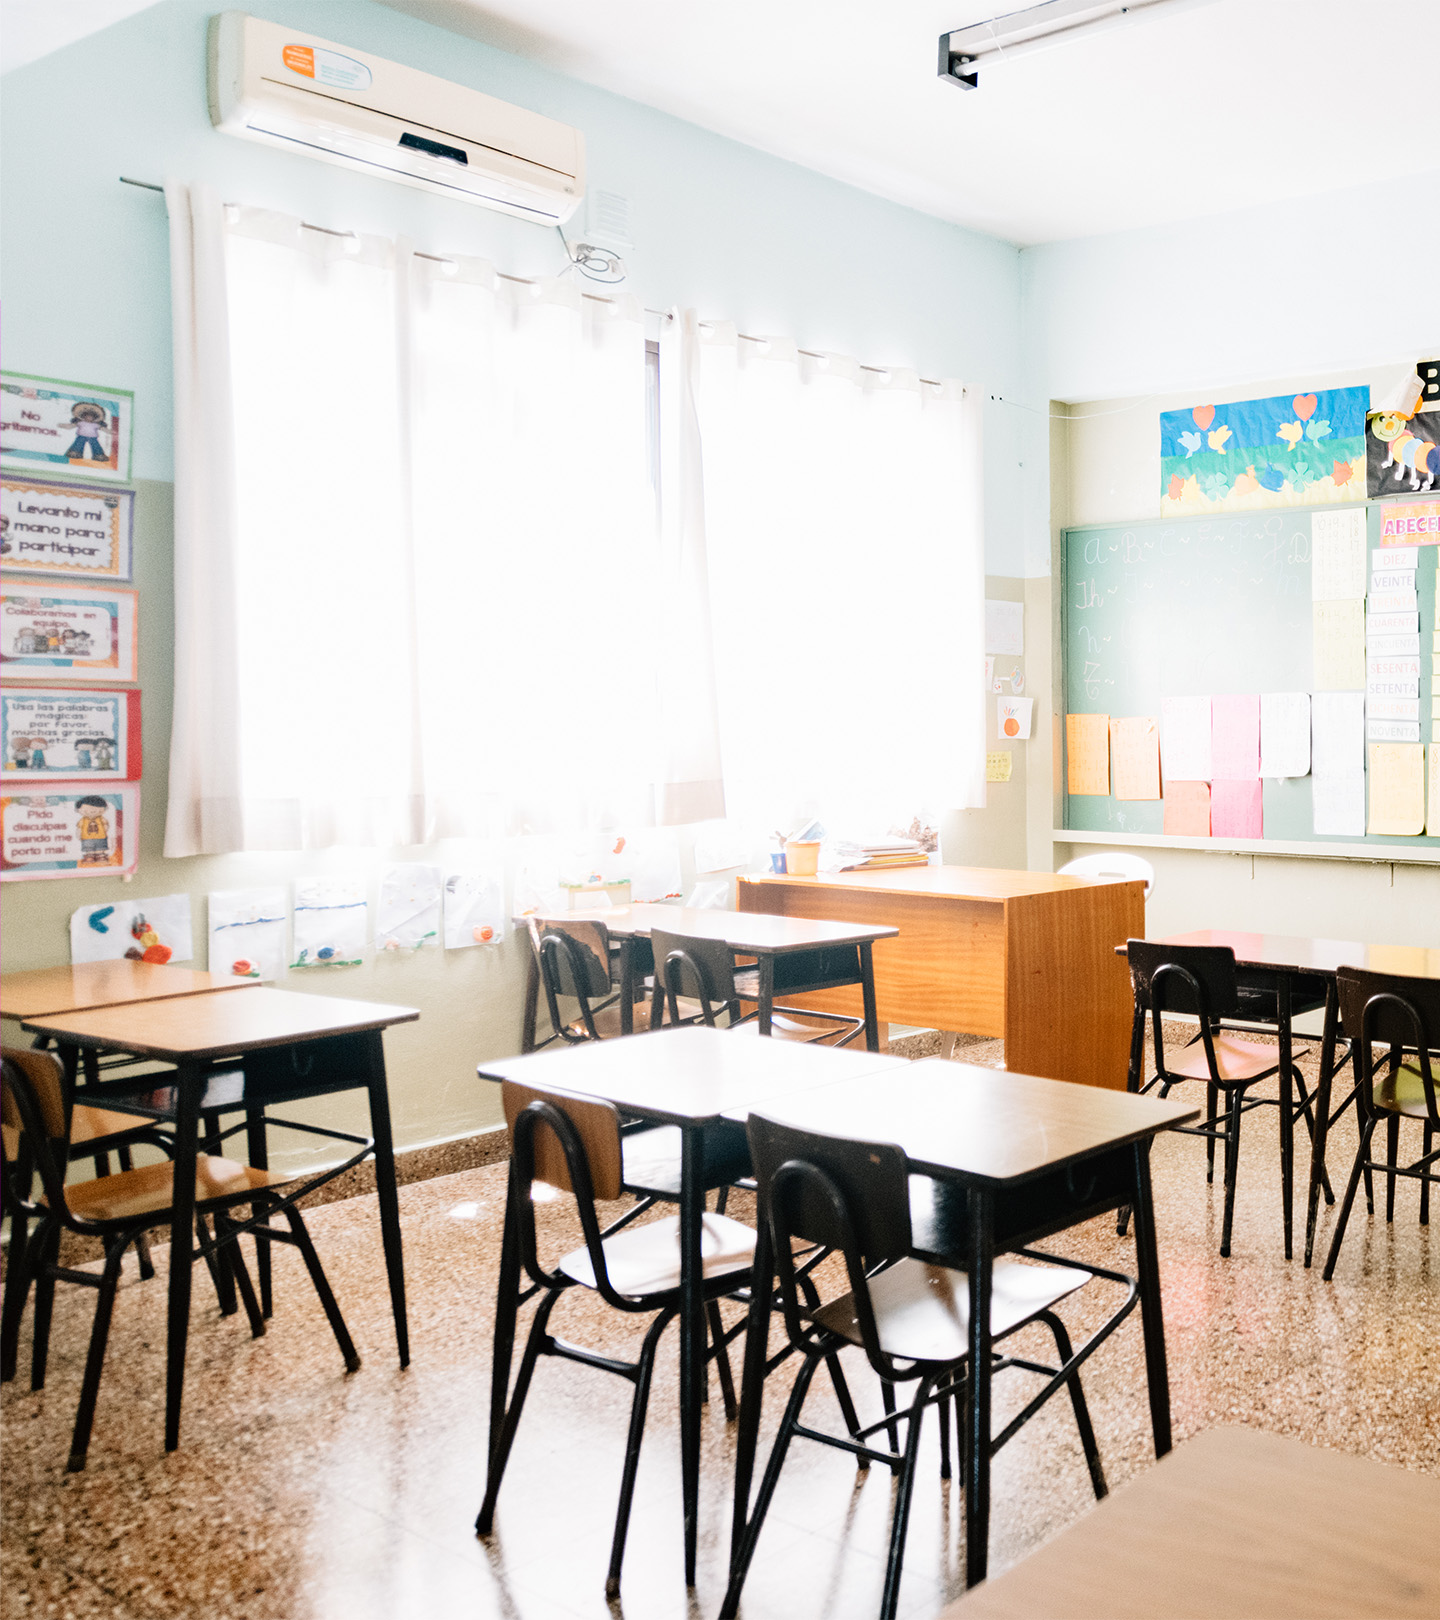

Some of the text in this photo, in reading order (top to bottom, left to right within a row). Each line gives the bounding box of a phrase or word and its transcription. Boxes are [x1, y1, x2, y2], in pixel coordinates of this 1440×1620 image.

[21, 410, 41, 421] No
[18, 501, 102, 521] Levanto mi
[14, 522, 105, 539] mano para
[19, 541, 100, 557] participar
[1383, 554, 1407, 565] DIEZ
[1374, 576, 1413, 587] VEINTE
[1371, 596, 1415, 608] TREINTA
[5, 607, 77, 619] Colaboramos
[1369, 616, 1416, 628] CUARENTA
[1370, 638, 1417, 649] CINCUENTA
[1370, 662, 1418, 674] SESENTA
[1369, 683, 1417, 694] SETENTA
[12, 703, 109, 713] Usa las palabras
[1369, 703, 1416, 714] OCHENTA
[1370, 726, 1417, 738] NOVENTA
[27, 810, 53, 819] Pido
[12, 822, 68, 832] disculpas
[7, 834, 73, 844] cuando me
[11, 847, 41, 857] porto
